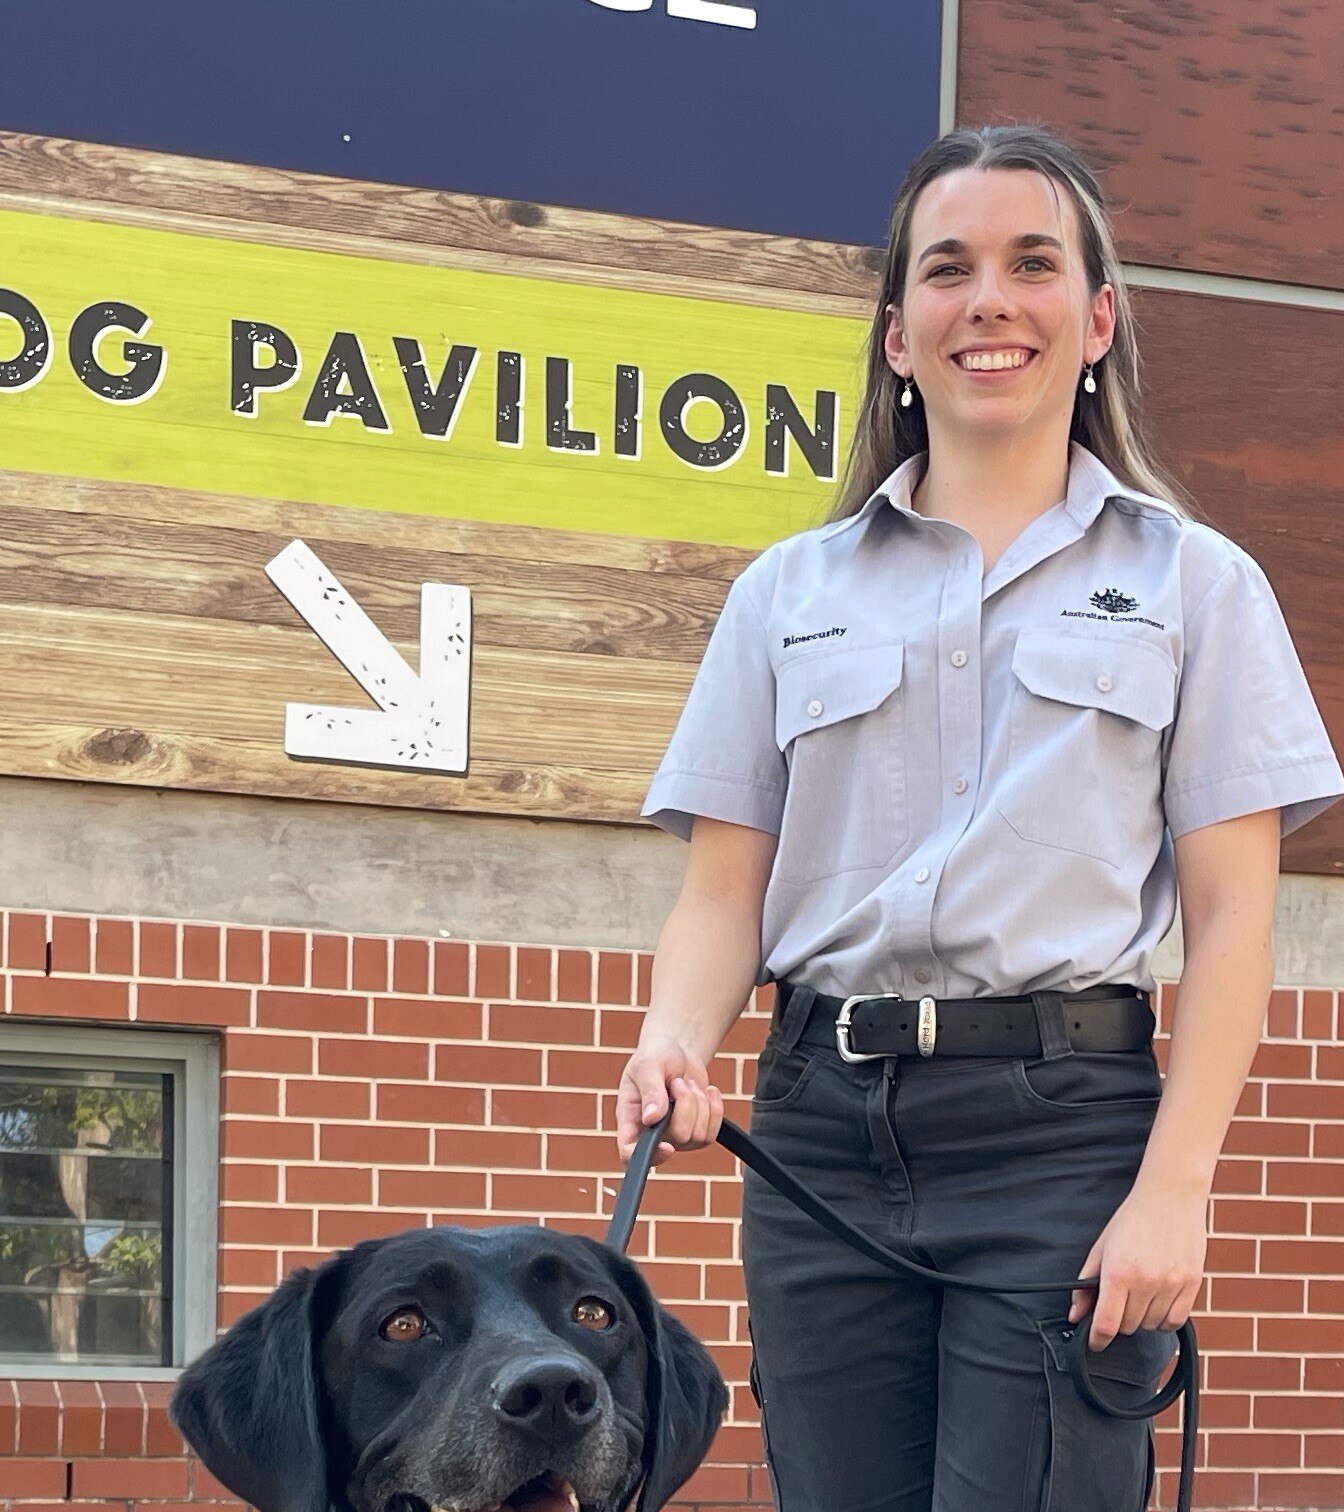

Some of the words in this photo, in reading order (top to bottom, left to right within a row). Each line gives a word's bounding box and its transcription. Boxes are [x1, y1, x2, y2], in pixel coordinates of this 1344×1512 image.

[230, 318, 838, 482] PAVILION
[1060, 609, 1108, 622] Australian
[782, 626, 848, 649] Biosecurity
